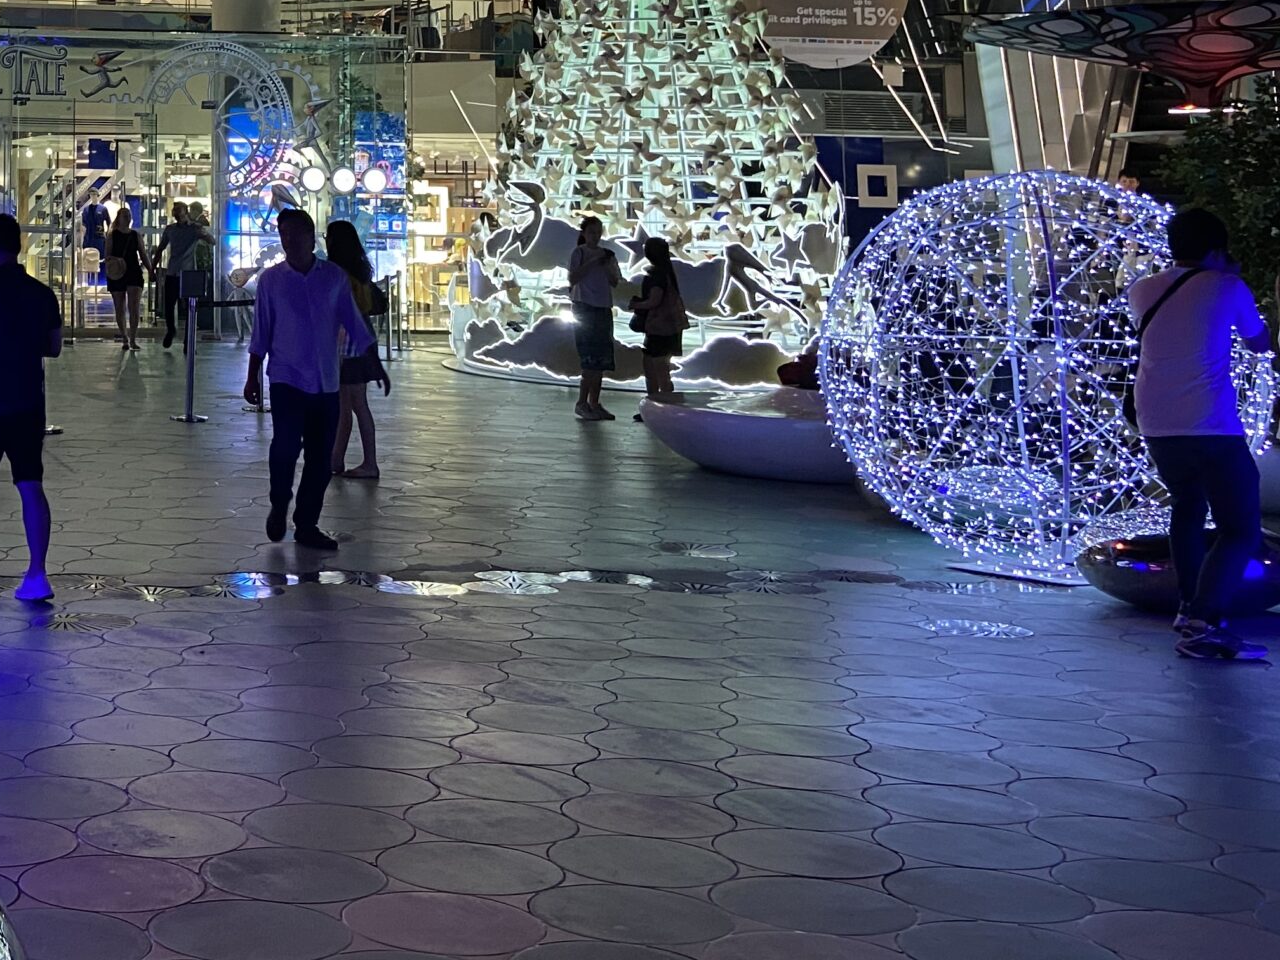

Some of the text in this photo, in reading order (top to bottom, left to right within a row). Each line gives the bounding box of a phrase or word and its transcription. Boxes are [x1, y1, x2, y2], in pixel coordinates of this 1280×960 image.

[780, 14, 801, 24] card
[802, 14, 848, 27] privileges
[796, 6, 847, 19] Get special
[852, 7, 898, 27] 15%
[0, 44, 68, 96] TALE
